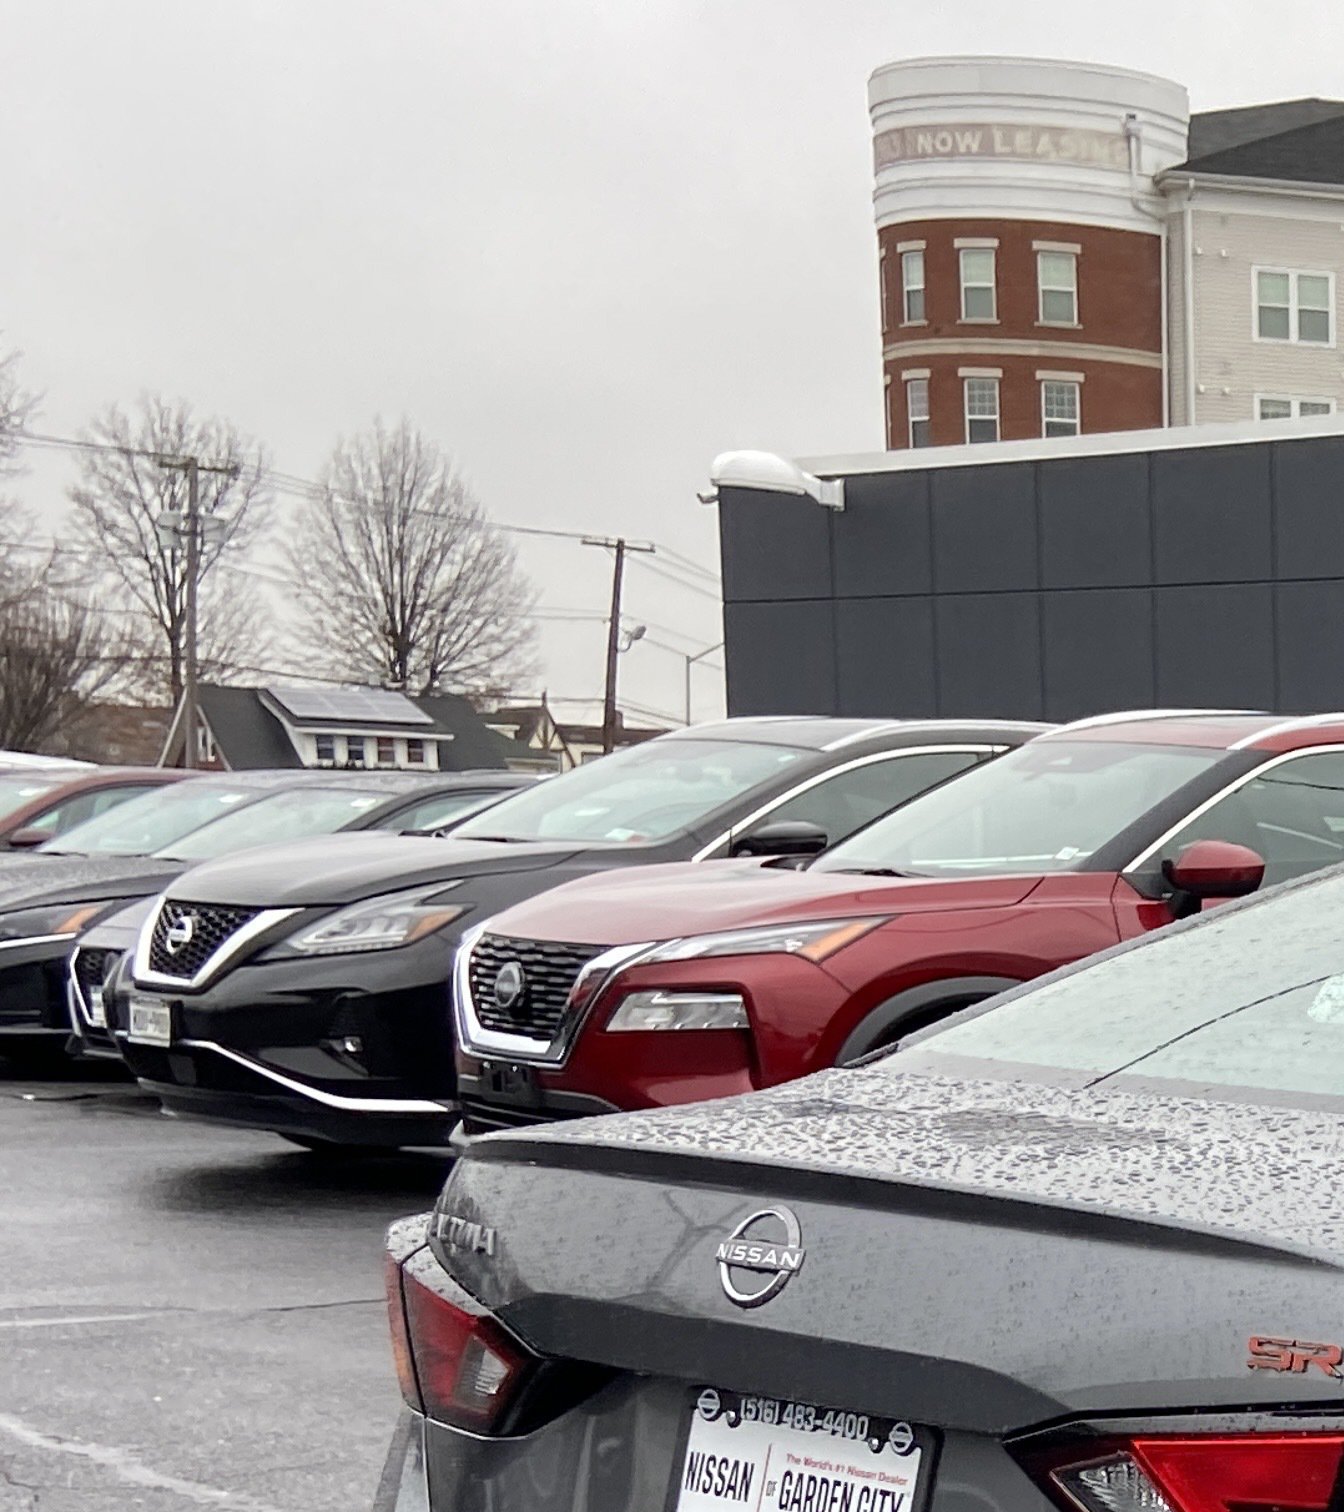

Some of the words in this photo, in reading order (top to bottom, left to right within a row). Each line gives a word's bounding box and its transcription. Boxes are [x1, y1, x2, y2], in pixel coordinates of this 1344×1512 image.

[916, 129, 982, 154] NOW
[716, 1243, 800, 1268] NISSAN
[1247, 1336, 1344, 1379] SR
[740, 1398, 780, 1425] (516)
[782, 1402, 868, 1441] 483-4400
[684, 1451, 754, 1502] NISSAN
